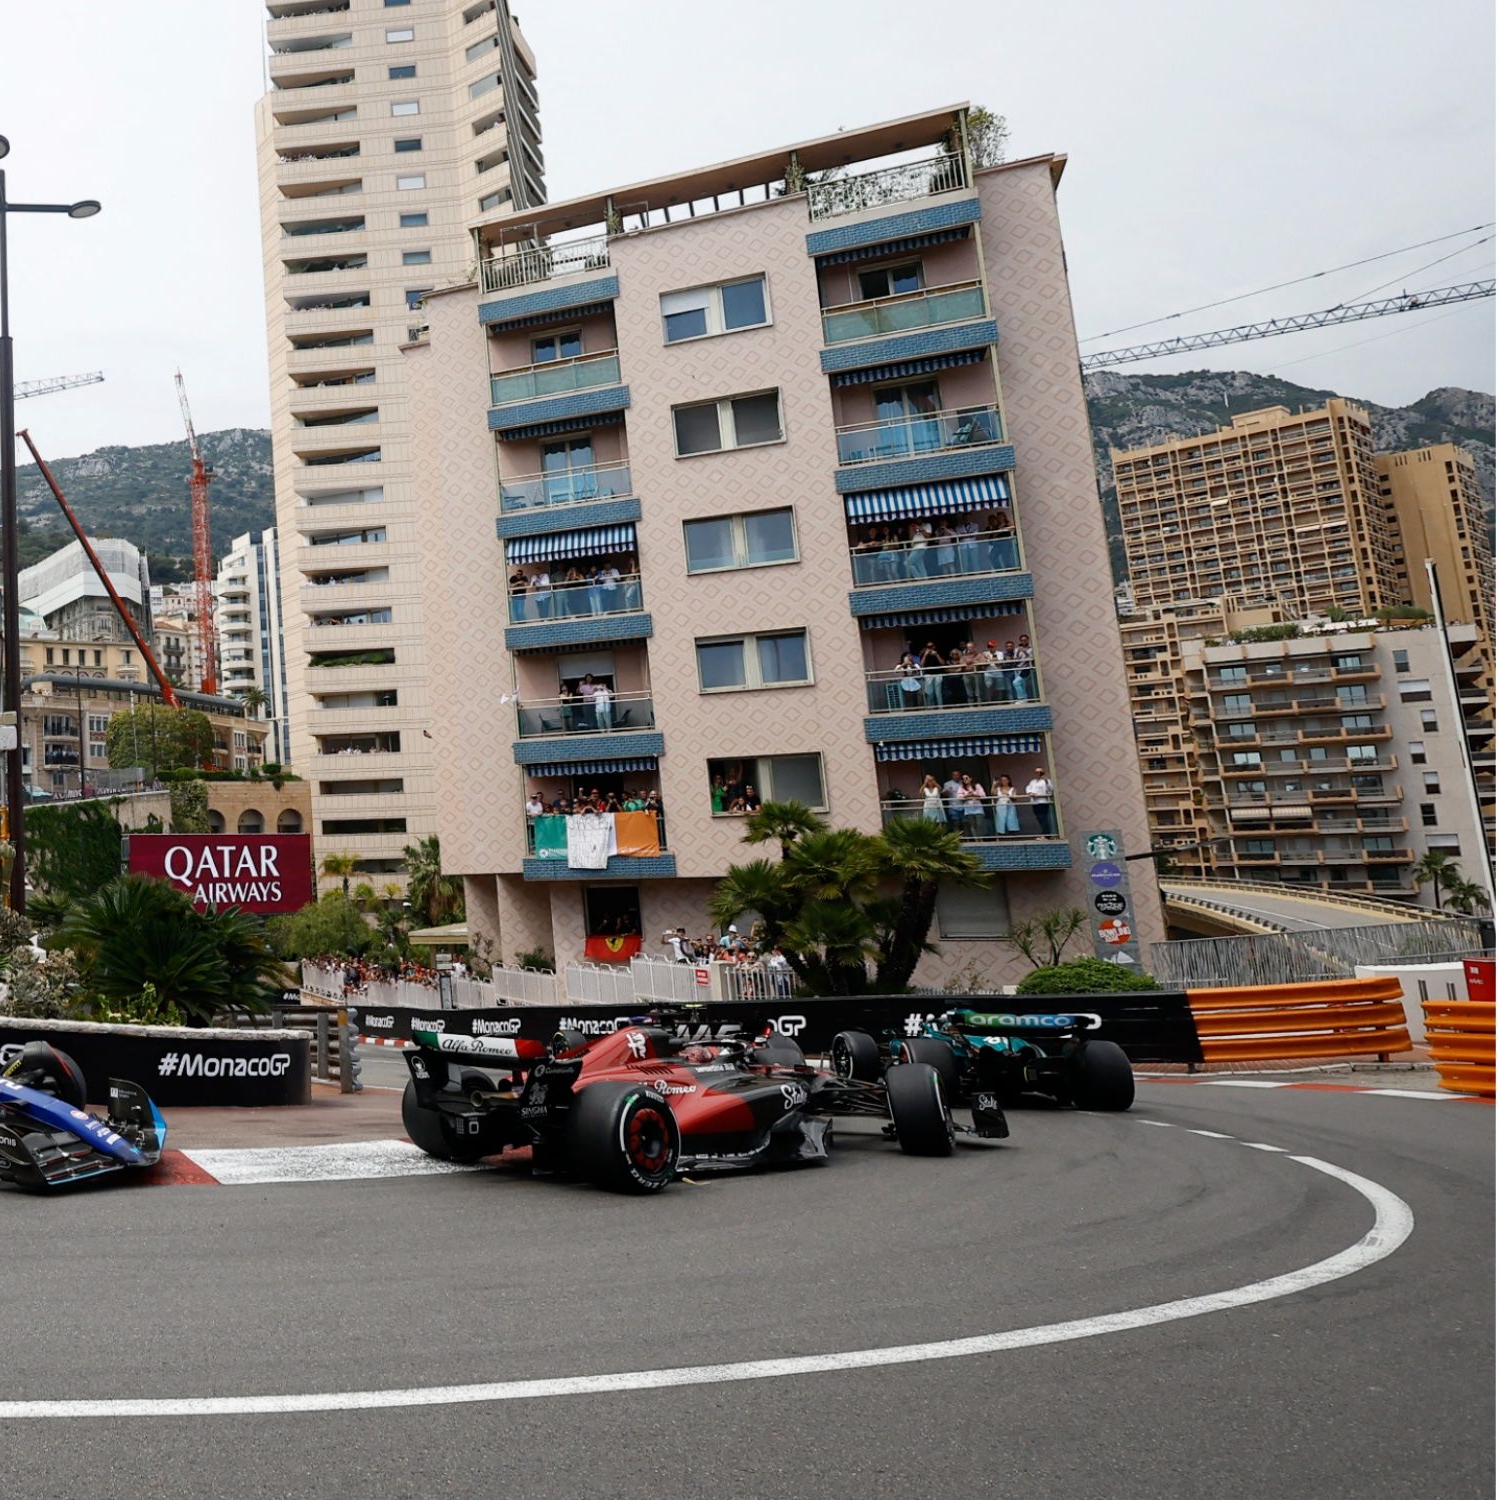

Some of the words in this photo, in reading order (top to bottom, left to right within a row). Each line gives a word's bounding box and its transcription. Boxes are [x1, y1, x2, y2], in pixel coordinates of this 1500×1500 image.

[164, 844, 280, 888] QATAR
[193, 881, 282, 904] AIRWAYS
[365, 1014, 394, 1028] #MonacoGP
[411, 1017, 446, 1032] #MonacoGP
[472, 1018, 521, 1034] #MonacoGP
[969, 1014, 1071, 1027] aramco
[441, 1038, 468, 1053] Alfa
[471, 1039, 513, 1055] Romeo
[158, 1052, 291, 1078] #MonacoGP
[654, 1079, 697, 1095] Romeo
[521, 1106, 548, 1116] SINGHA
